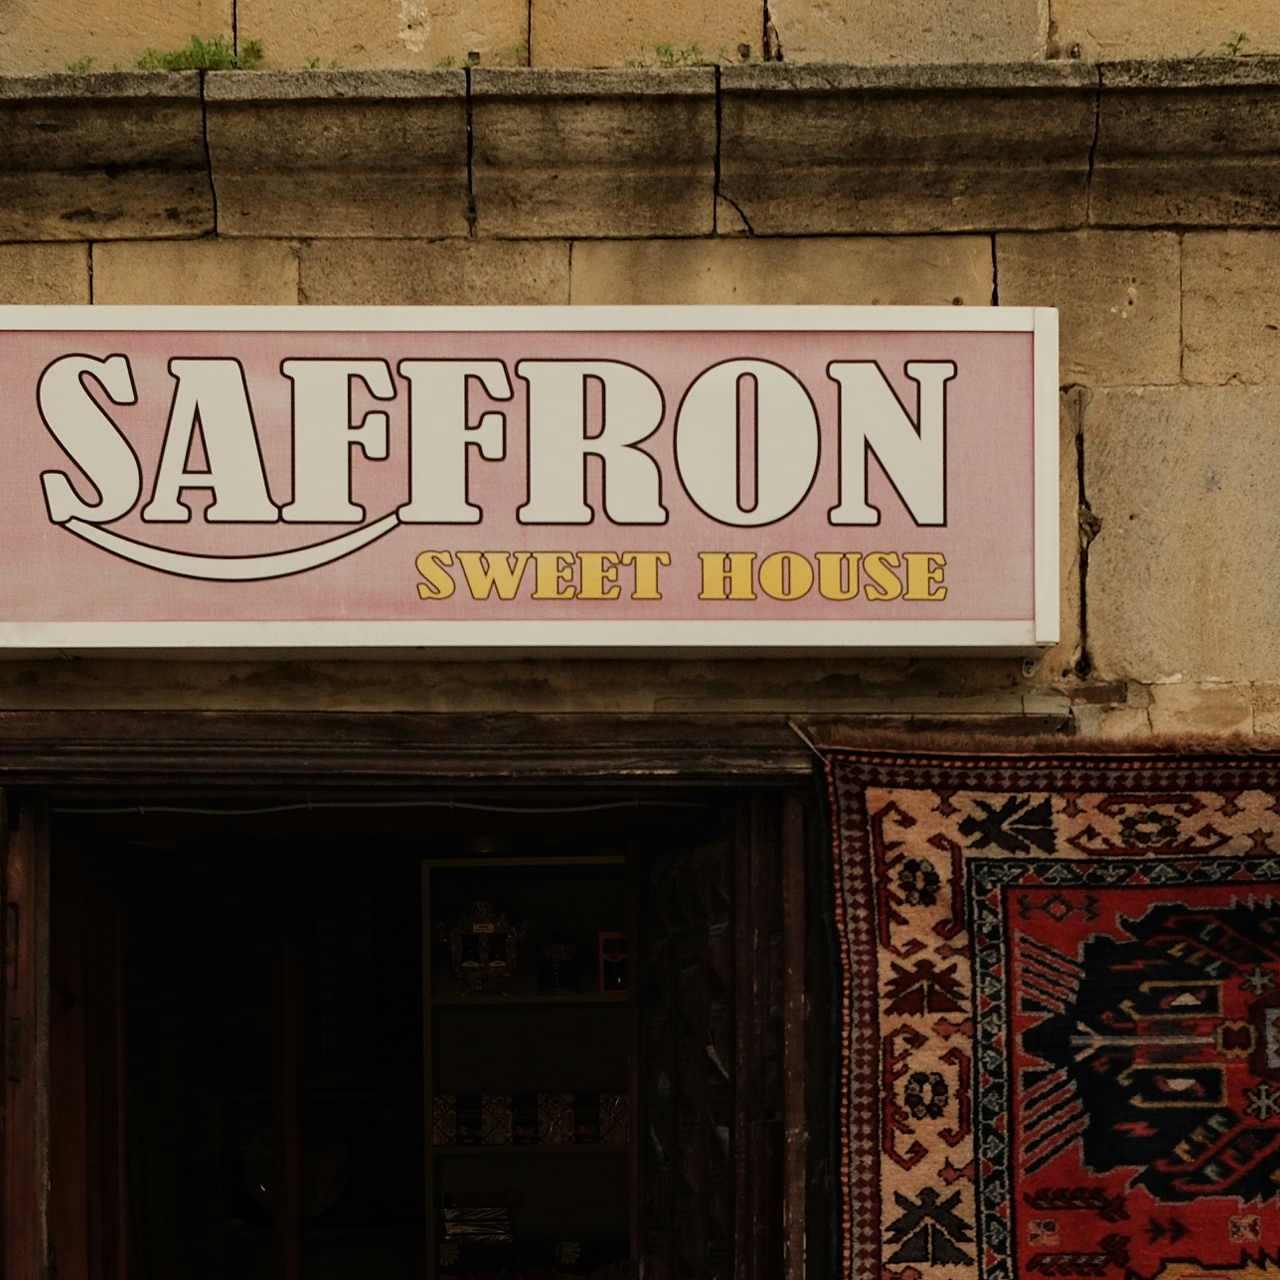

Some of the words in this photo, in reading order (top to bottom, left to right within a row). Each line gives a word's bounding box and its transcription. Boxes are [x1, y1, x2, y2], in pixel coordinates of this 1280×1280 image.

[36, 353, 958, 528] SAFFRON
[415, 550, 670, 602] SWEET
[697, 551, 948, 603] HOUSE
